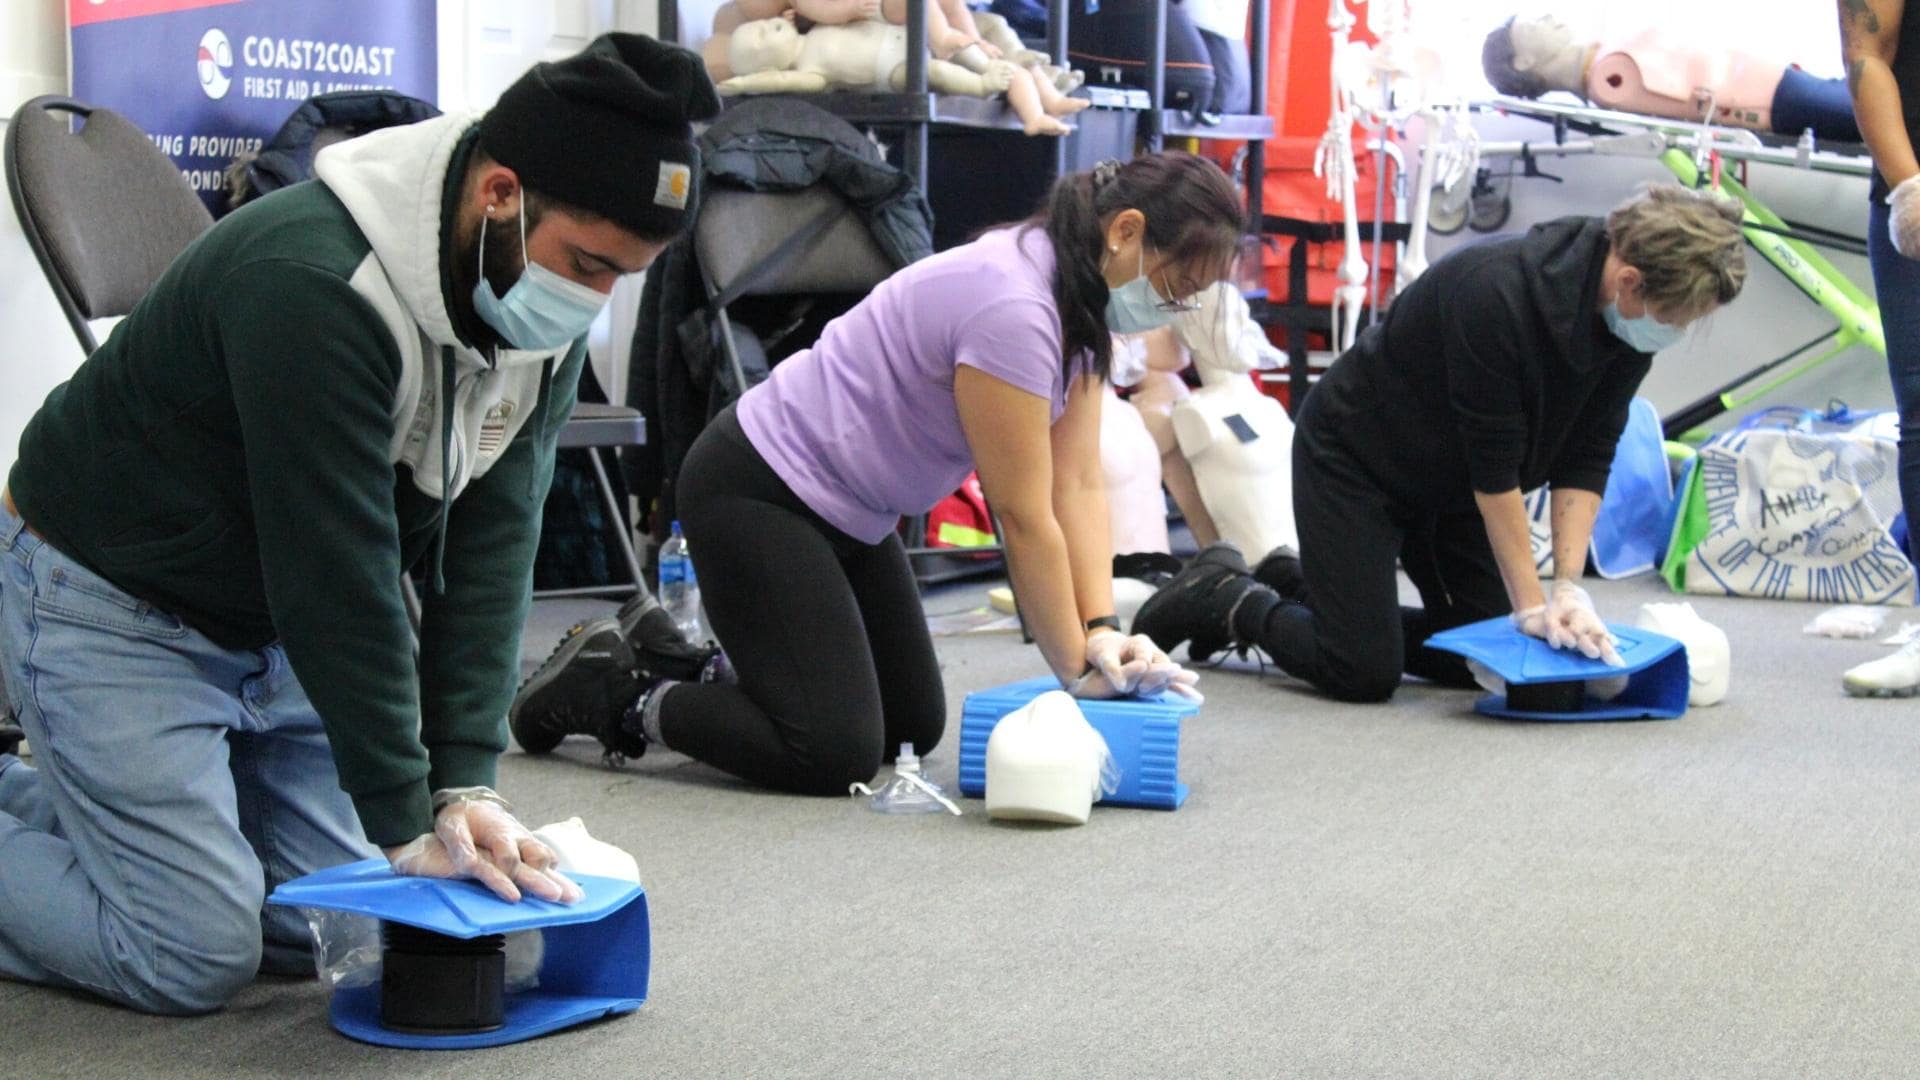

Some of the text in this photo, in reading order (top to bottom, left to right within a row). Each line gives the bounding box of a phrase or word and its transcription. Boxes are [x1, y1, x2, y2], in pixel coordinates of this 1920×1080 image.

[243, 36, 395, 76] COAST2COAST
[244, 77, 282, 98] FIRST
[285, 80, 309, 100] AID
[1751, 553, 1798, 600] THE
